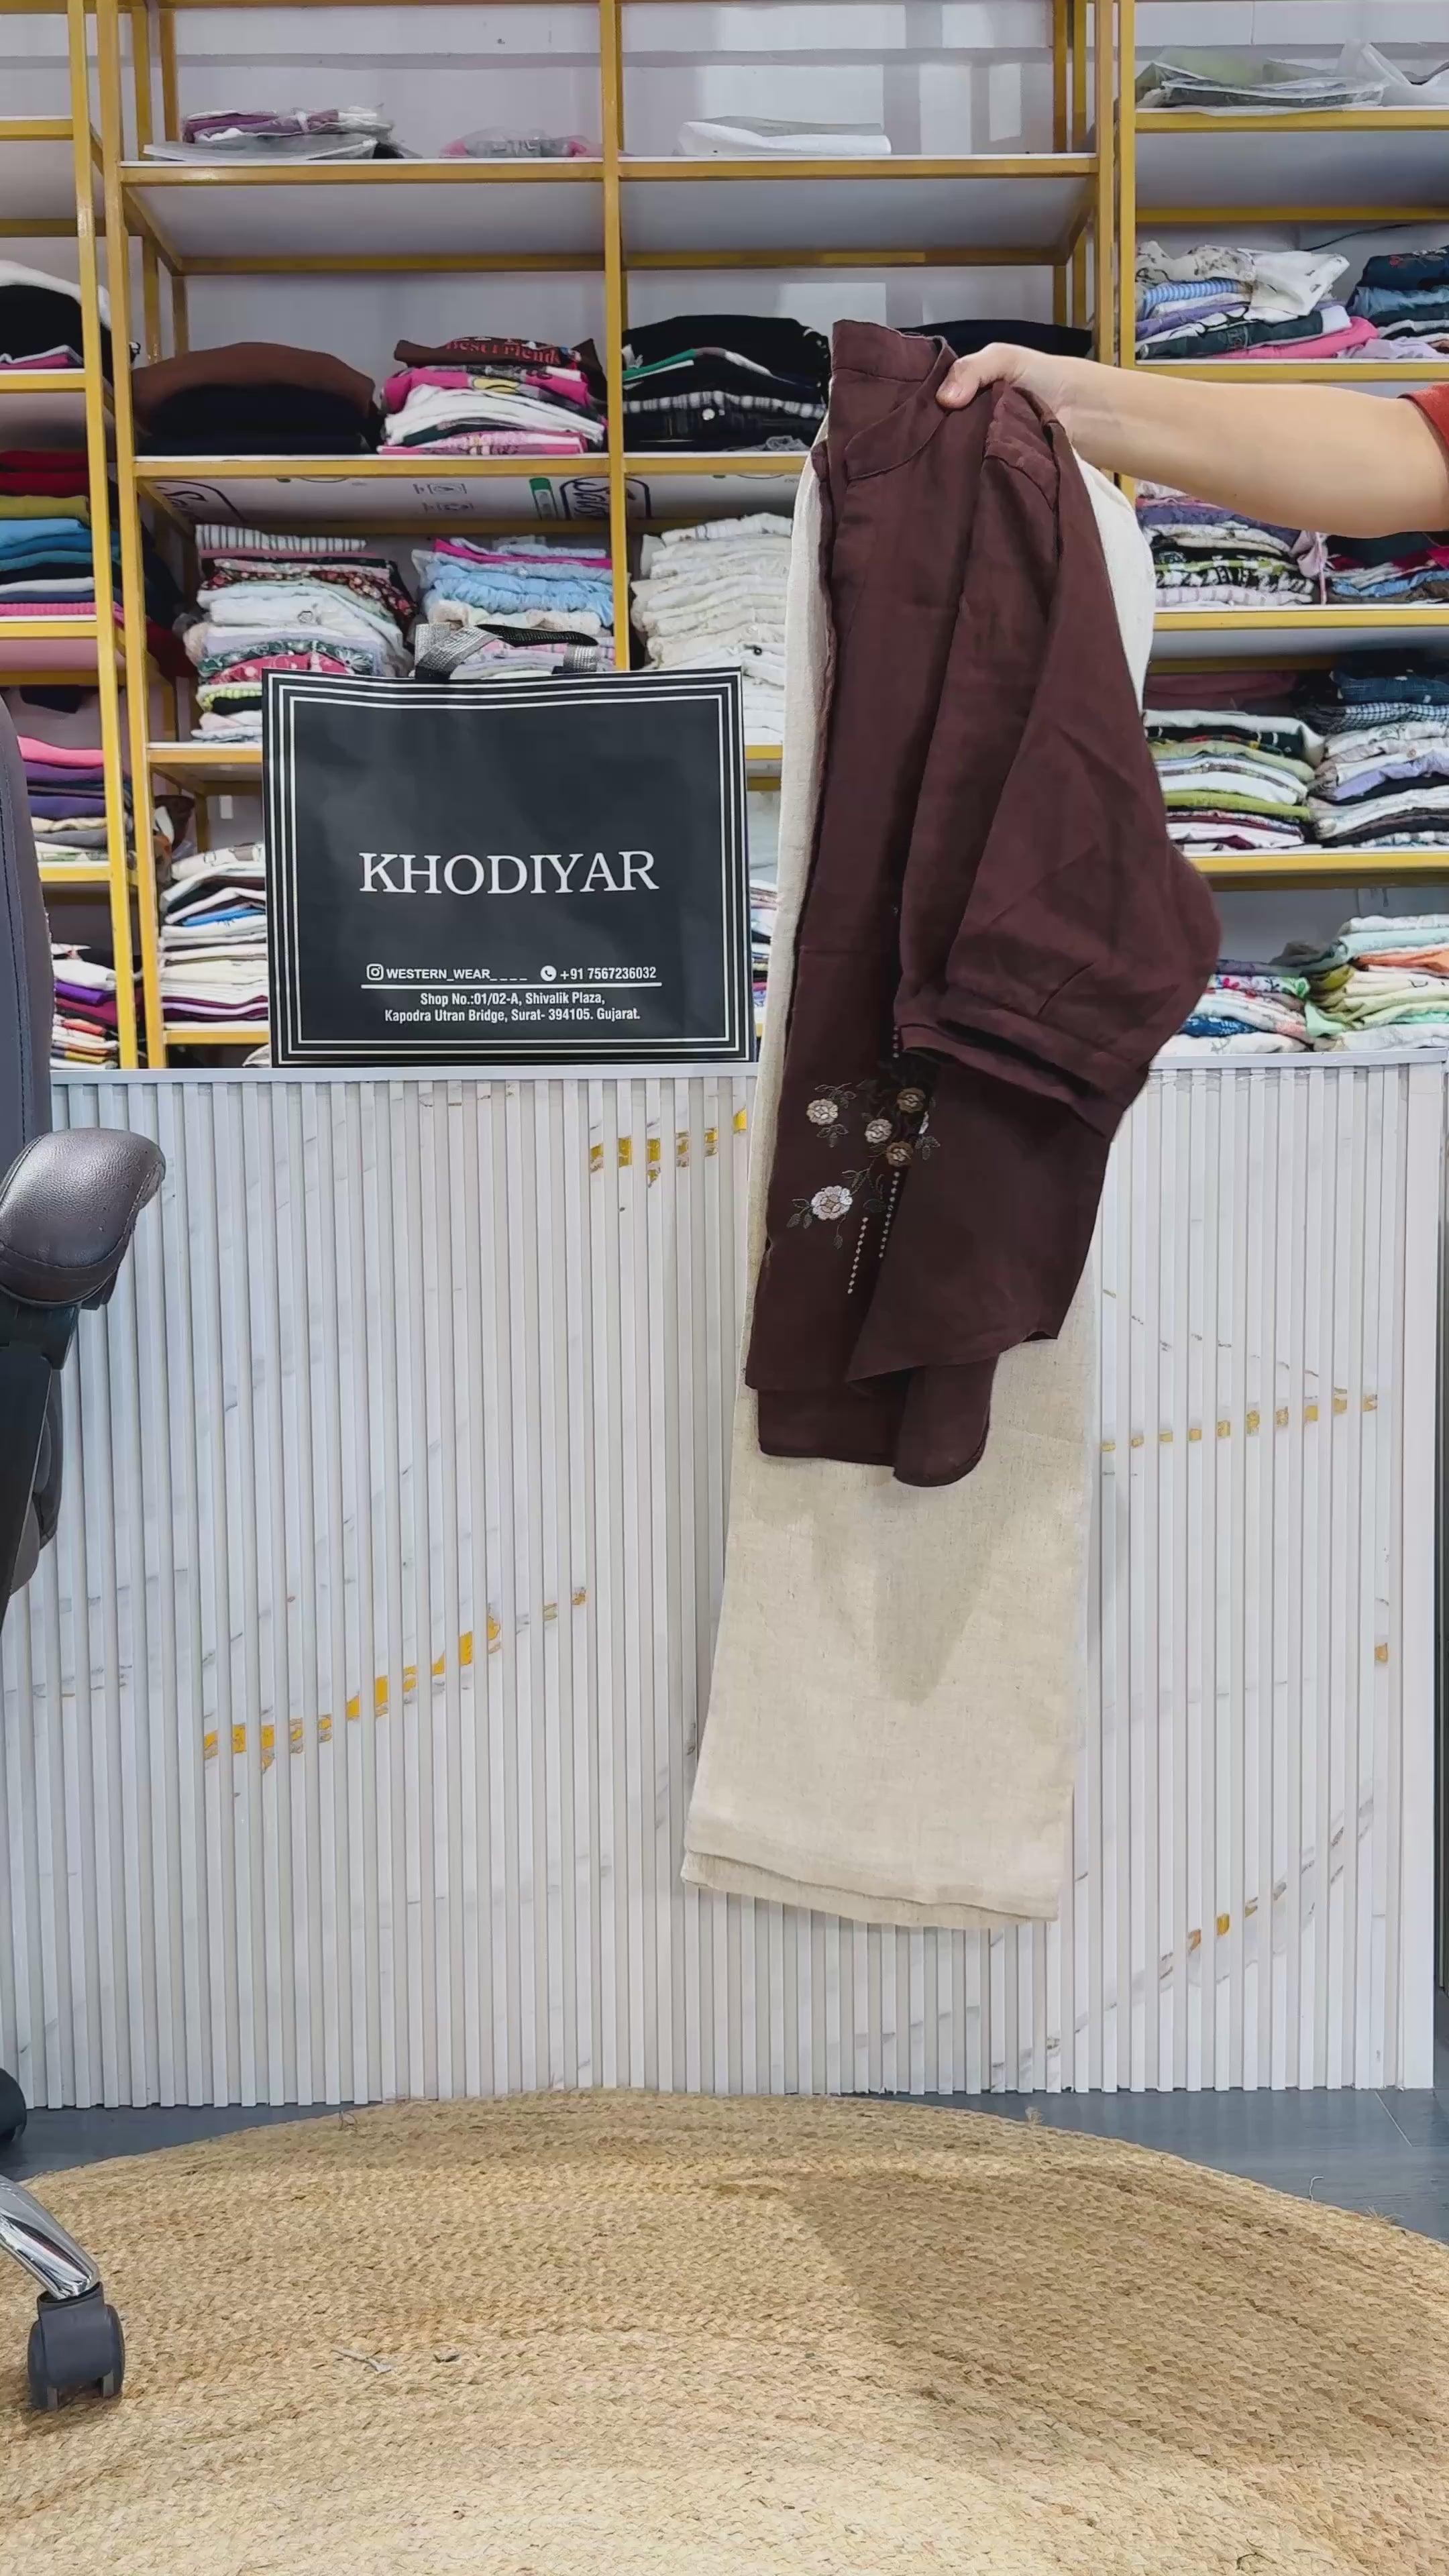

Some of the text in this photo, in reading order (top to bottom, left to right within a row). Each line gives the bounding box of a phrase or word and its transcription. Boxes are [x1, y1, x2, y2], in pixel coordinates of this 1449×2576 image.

[359, 851, 659, 895] KHODIYAR
[559, 966, 657, 980] +91 7567236032
[420, 992, 449, 1008] Shop
[525, 991, 570, 1005] Shivalik
[572, 991, 605, 1005] Plaza,
[384, 1007, 641, 1024] Kapodra Utran Bridge, Surat- 394105. Gujarat.
